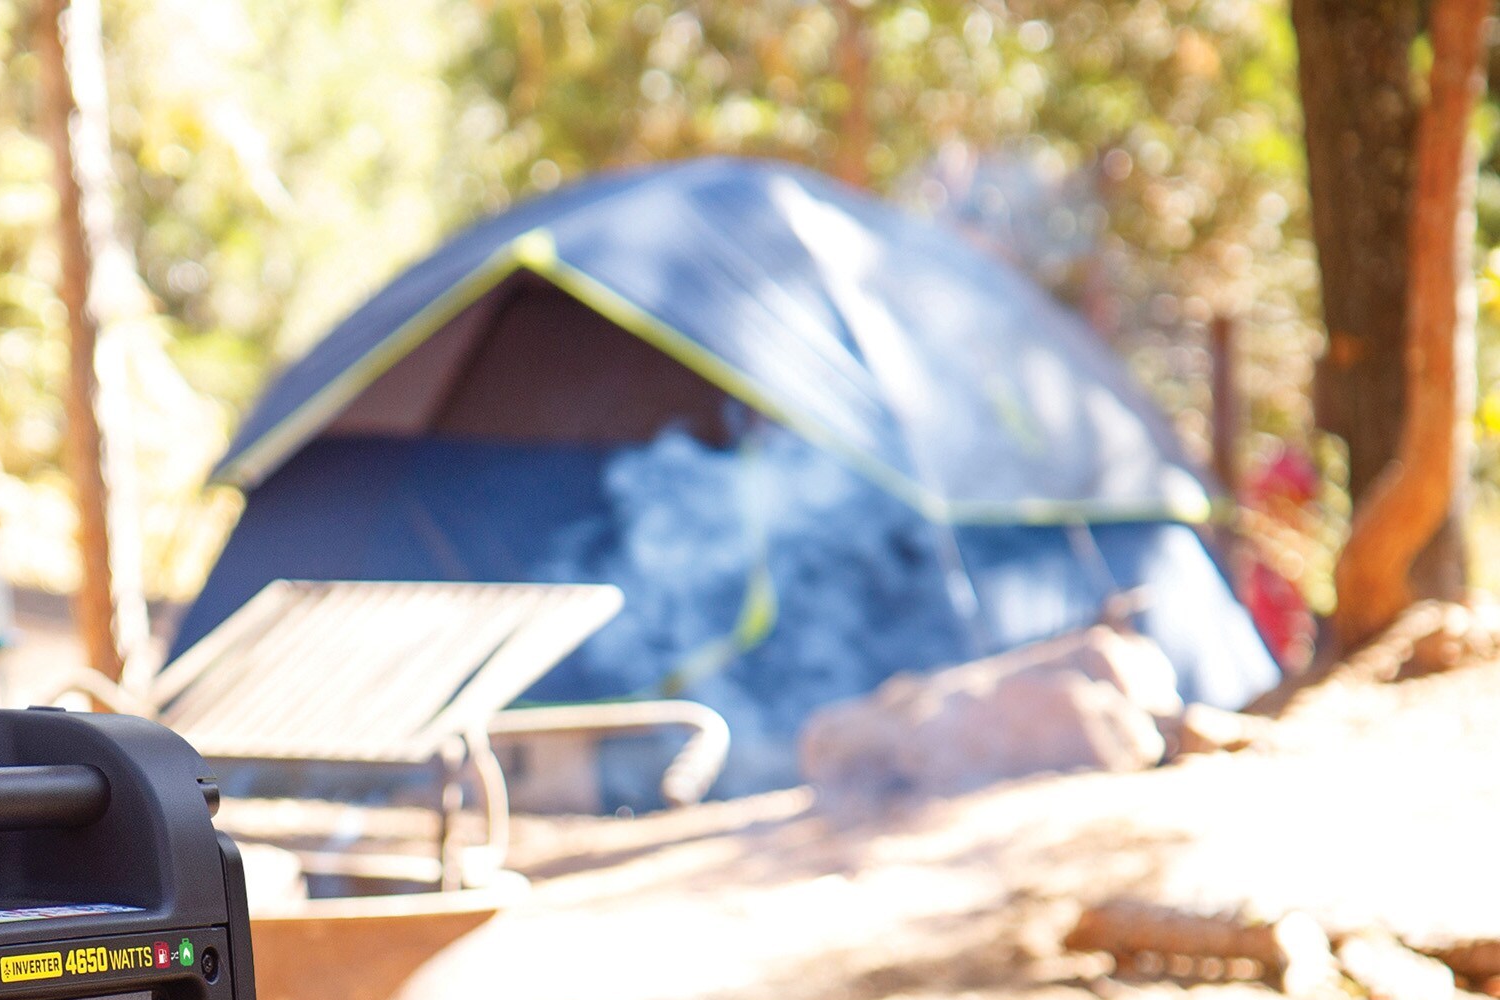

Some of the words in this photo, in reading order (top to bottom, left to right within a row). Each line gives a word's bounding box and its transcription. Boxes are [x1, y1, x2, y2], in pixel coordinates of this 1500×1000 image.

[12, 958, 60, 976] INVERTER
[65, 946, 109, 975] 4650
[108, 946, 153, 970] WATTS
